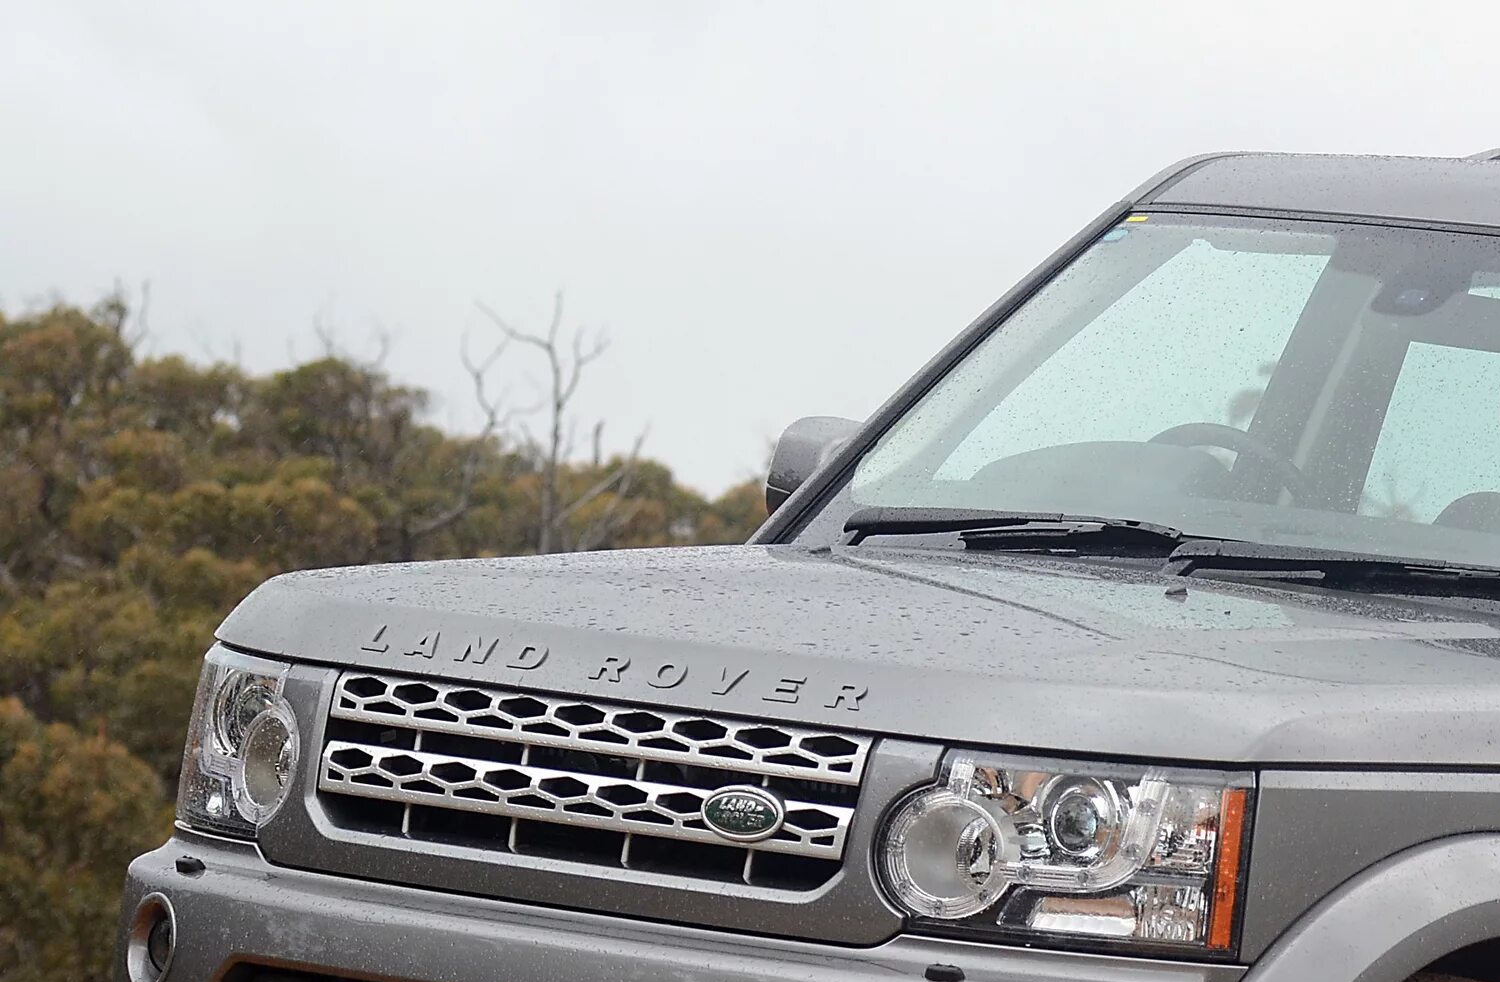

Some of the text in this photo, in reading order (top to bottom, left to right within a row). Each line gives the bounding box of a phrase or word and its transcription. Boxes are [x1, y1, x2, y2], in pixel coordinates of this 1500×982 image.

[361, 625, 869, 712] LAND ROVER
[718, 796, 757, 812] LAND
